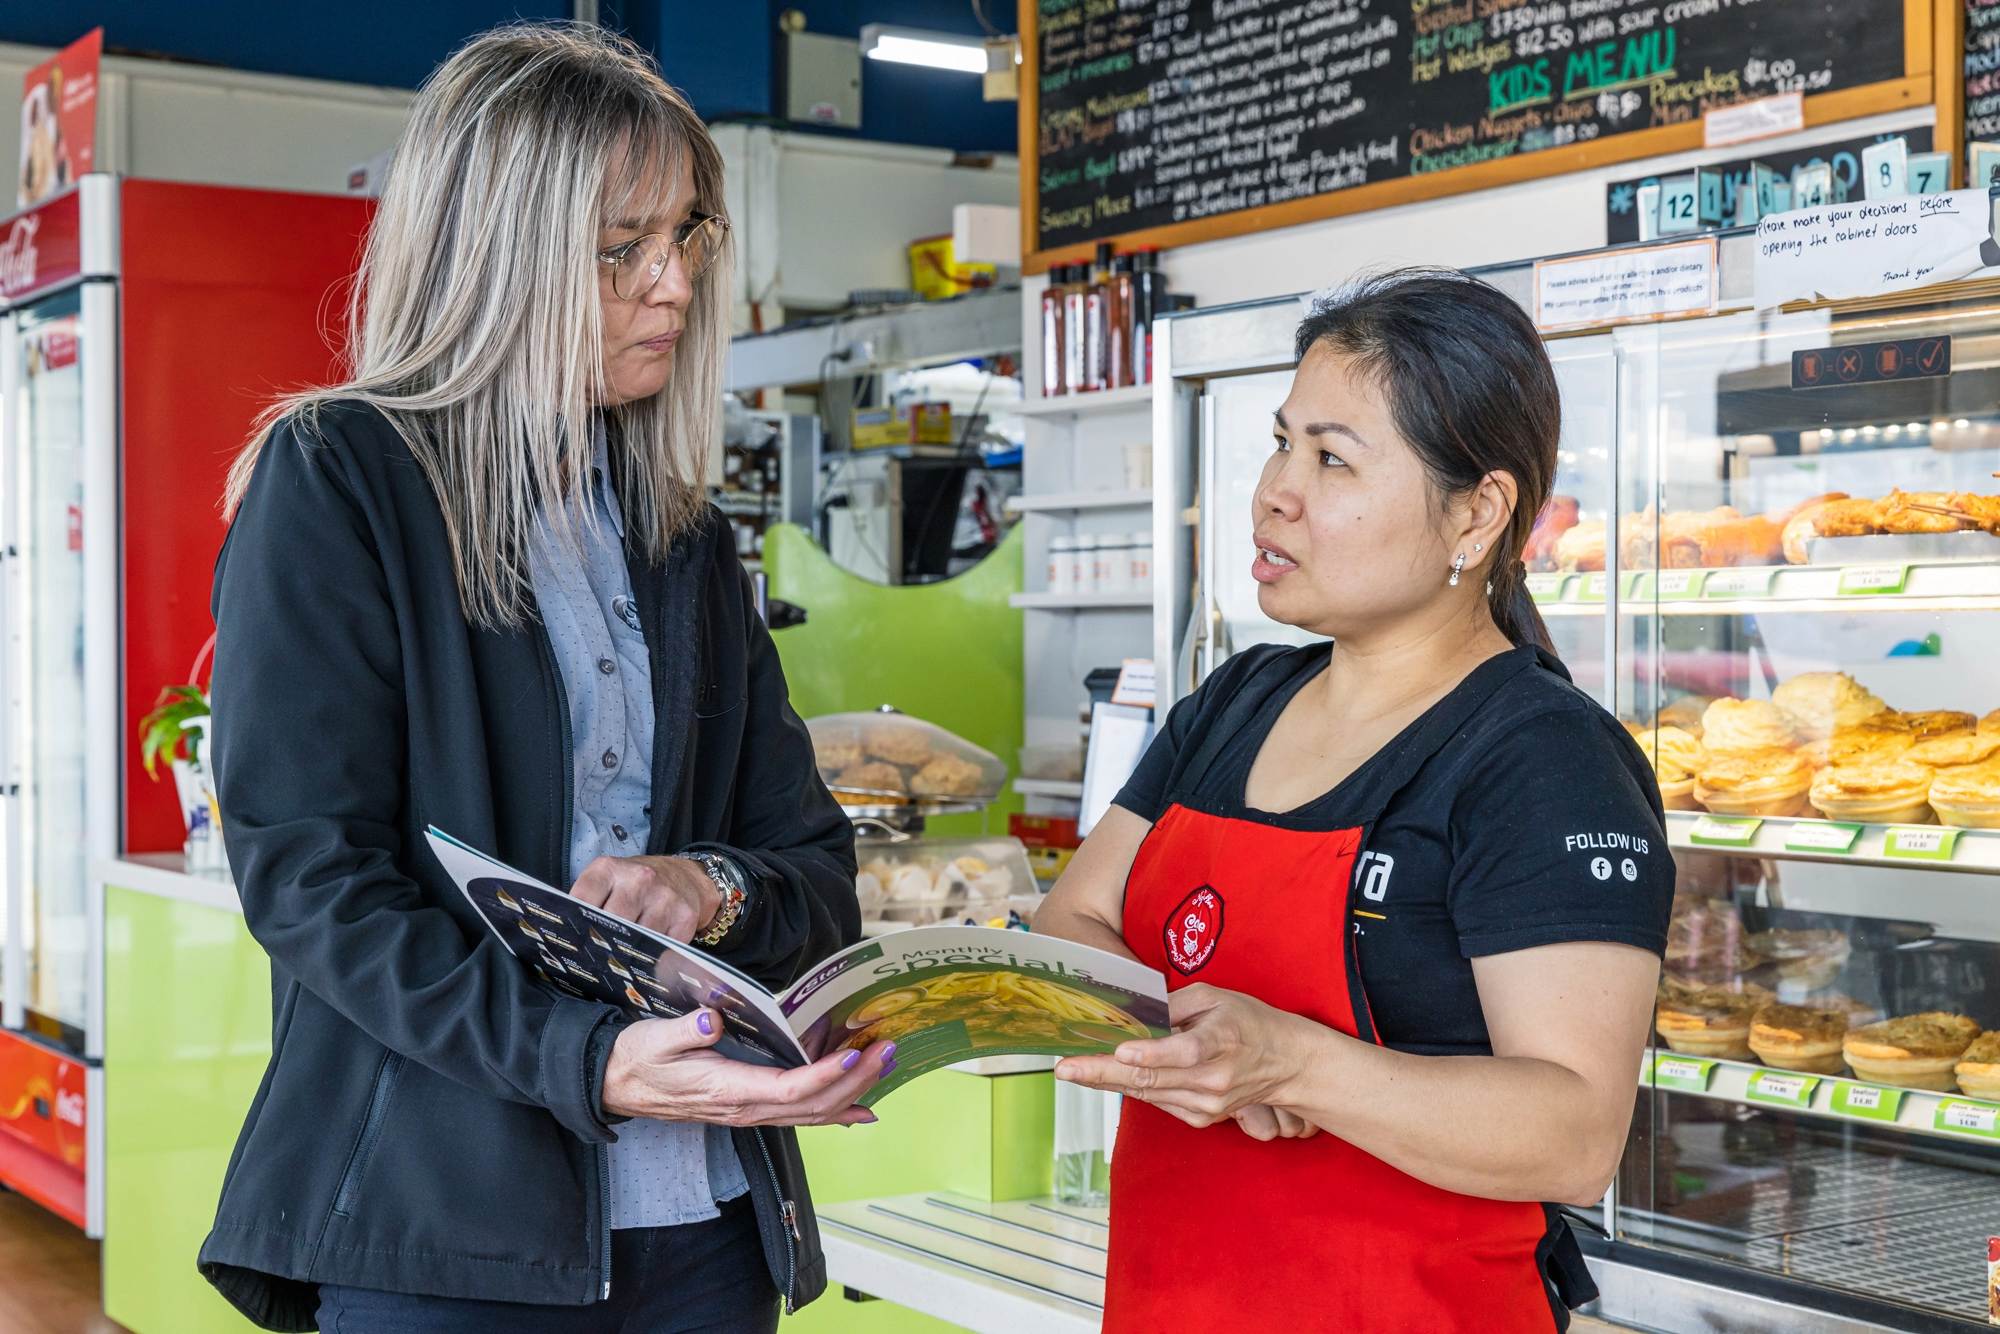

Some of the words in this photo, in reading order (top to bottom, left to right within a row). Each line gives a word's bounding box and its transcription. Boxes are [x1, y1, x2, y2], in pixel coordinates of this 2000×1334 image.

[1443, 19, 1486, 50] Chips
[1447, 40, 1512, 75] Wedges
[1578, 16, 1616, 44] with
[1618, 7, 1660, 36] sour
[1488, 57, 1552, 113] KIDS
[1563, 25, 1677, 97] MENU
[1650, 65, 1741, 108] Pancakes
[1410, 123, 1475, 157] Chicken
[1880, 163, 1892, 188] 8
[1917, 171, 1932, 194] 7
[1667, 193, 1695, 219] 12
[1708, 186, 1715, 212] 1
[1756, 218, 1786, 237] Please
[1793, 213, 1822, 228] make
[1827, 209, 1853, 229] your
[1859, 202, 1908, 220] decisions
[1920, 195, 1954, 215] before
[1761, 238, 1803, 258] opening
[1809, 233, 1828, 248] the
[1835, 223, 1877, 243] cabinet
[1884, 221, 1918, 237] doors
[1568, 277, 1588, 287] advise
[1656, 265, 1678, 276] and/or
[1882, 271, 1910, 283] Thank
[1565, 832, 1630, 852] FOLLOW
[1632, 836, 1649, 854] US
[901, 945, 1004, 961] Monthly
[872, 953, 1095, 981] Specials
